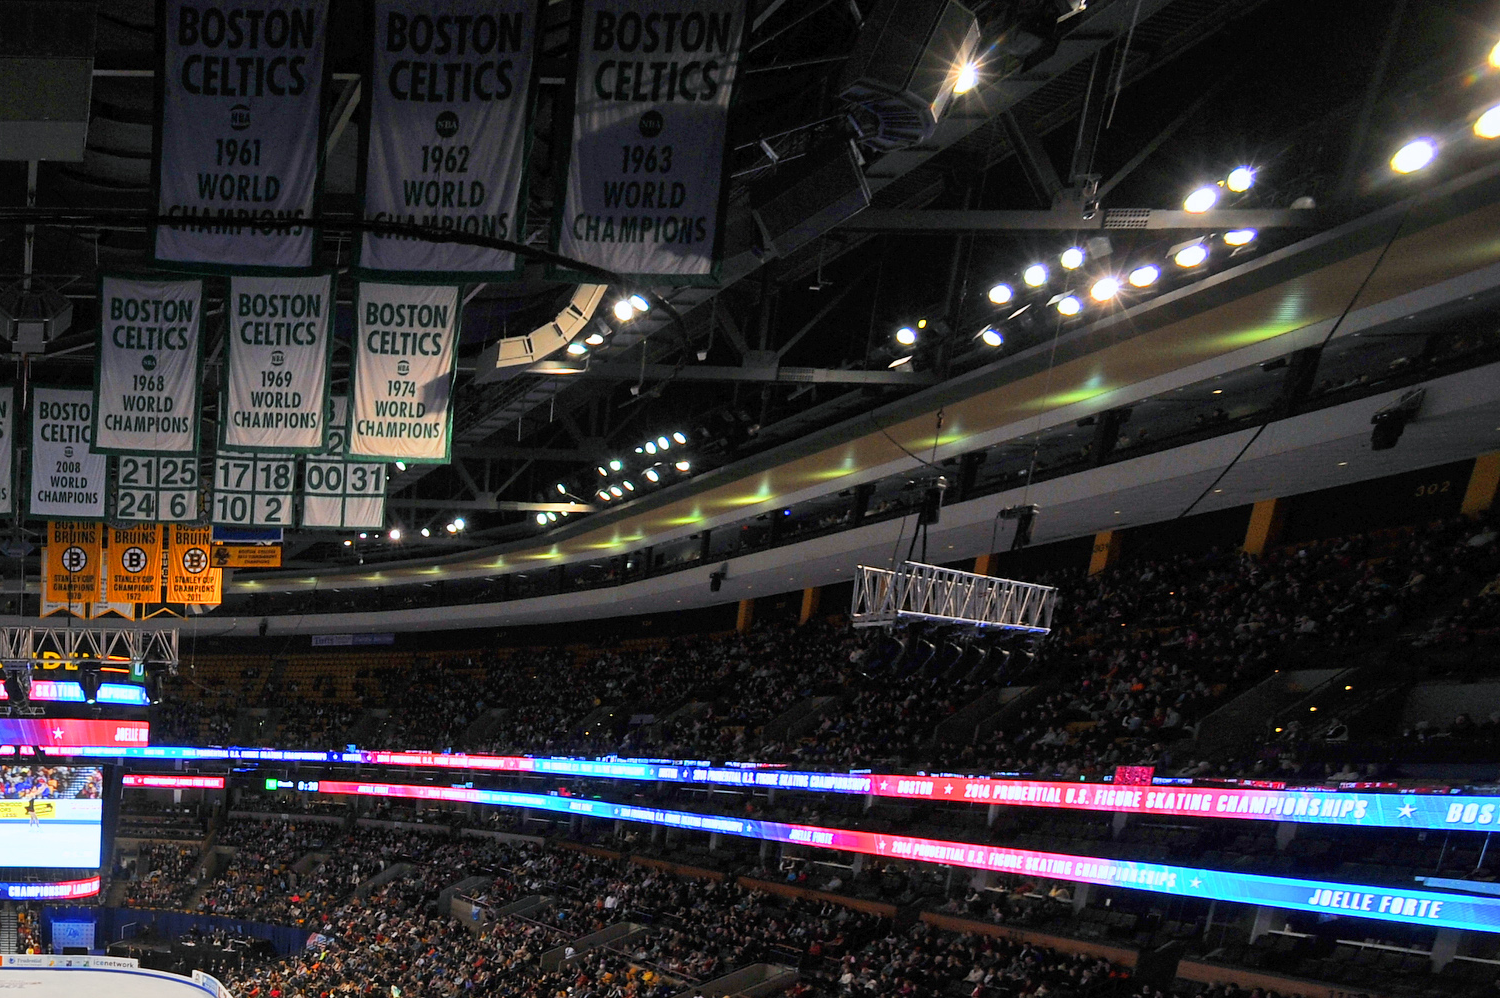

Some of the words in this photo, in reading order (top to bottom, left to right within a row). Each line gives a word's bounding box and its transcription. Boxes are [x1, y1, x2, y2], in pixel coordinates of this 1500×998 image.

[178, 6, 314, 50] BOSTON
[386, 10, 523, 55] BOSTON
[592, 11, 731, 54] BOSTON
[181, 55, 306, 97] CELTICS
[388, 59, 513, 102] CELTICS
[594, 59, 718, 102] CELTICS
[216, 138, 262, 167] 1961
[421, 144, 469, 174] 1962
[621, 144, 673, 174] 1963
[603, 180, 686, 210] WORLD
[573, 212, 707, 245] CHAMPIONS
[110, 297, 193, 324] BOSTON
[238, 293, 321, 318] BOSTON
[365, 302, 448, 329] BOSTON
[112, 325, 188, 351] CELTICS
[240, 320, 317, 346] CELTICS
[366, 330, 442, 356] CELTICS
[132, 374, 165, 392] 1968
[261, 371, 293, 388] 1969
[387, 380, 417, 398] 1974
[122, 394, 174, 413] WORLD
[251, 391, 302, 409] WORLD
[375, 400, 426, 419] WORLD
[104, 414, 189, 434] CHAMPIONS
[233, 410, 317, 430] CHAMPIONS
[357, 419, 441, 439] CHAMPIONS
[55, 460, 81, 474] 2008
[121, 459, 155, 486] 21
[160, 459, 197, 485] 25
[219, 463, 249, 488] 17
[260, 464, 290, 490] 18
[307, 465, 343, 490] 00
[351, 467, 382, 492] 31
[49, 475, 88, 489] WORLD
[37, 489, 98, 505] CHAMPIONS
[118, 491, 155, 518] 24
[169, 491, 187, 517] 6
[218, 496, 248, 522] 10
[263, 497, 281, 522] 2
[114, 531, 156, 545] BRUINS
[897, 780, 934, 795] BOSTON
[964, 783, 990, 799] 2014
[992, 785, 1061, 804] PRUDENTIAL
[1064, 788, 1090, 806] U.S.
[1094, 789, 1143, 809] FIGURE
[1146, 792, 1213, 812] SKATING
[1216, 794, 1368, 819] CHAMPIONSHIPS
[892, 841, 911, 855] 2014
[914, 843, 965, 862] PRUDENTIAL
[967, 848, 986, 866] U.S.
[988, 852, 1022, 870] FIGURE
[1025, 856, 1072, 876] SKATING
[1074, 861, 1177, 888] CHAMPIONSHIPS
[1308, 888, 1373, 912] JOELLE
[1379, 895, 1442, 919] FORTE
[93, 959, 134, 969] icenetwork
